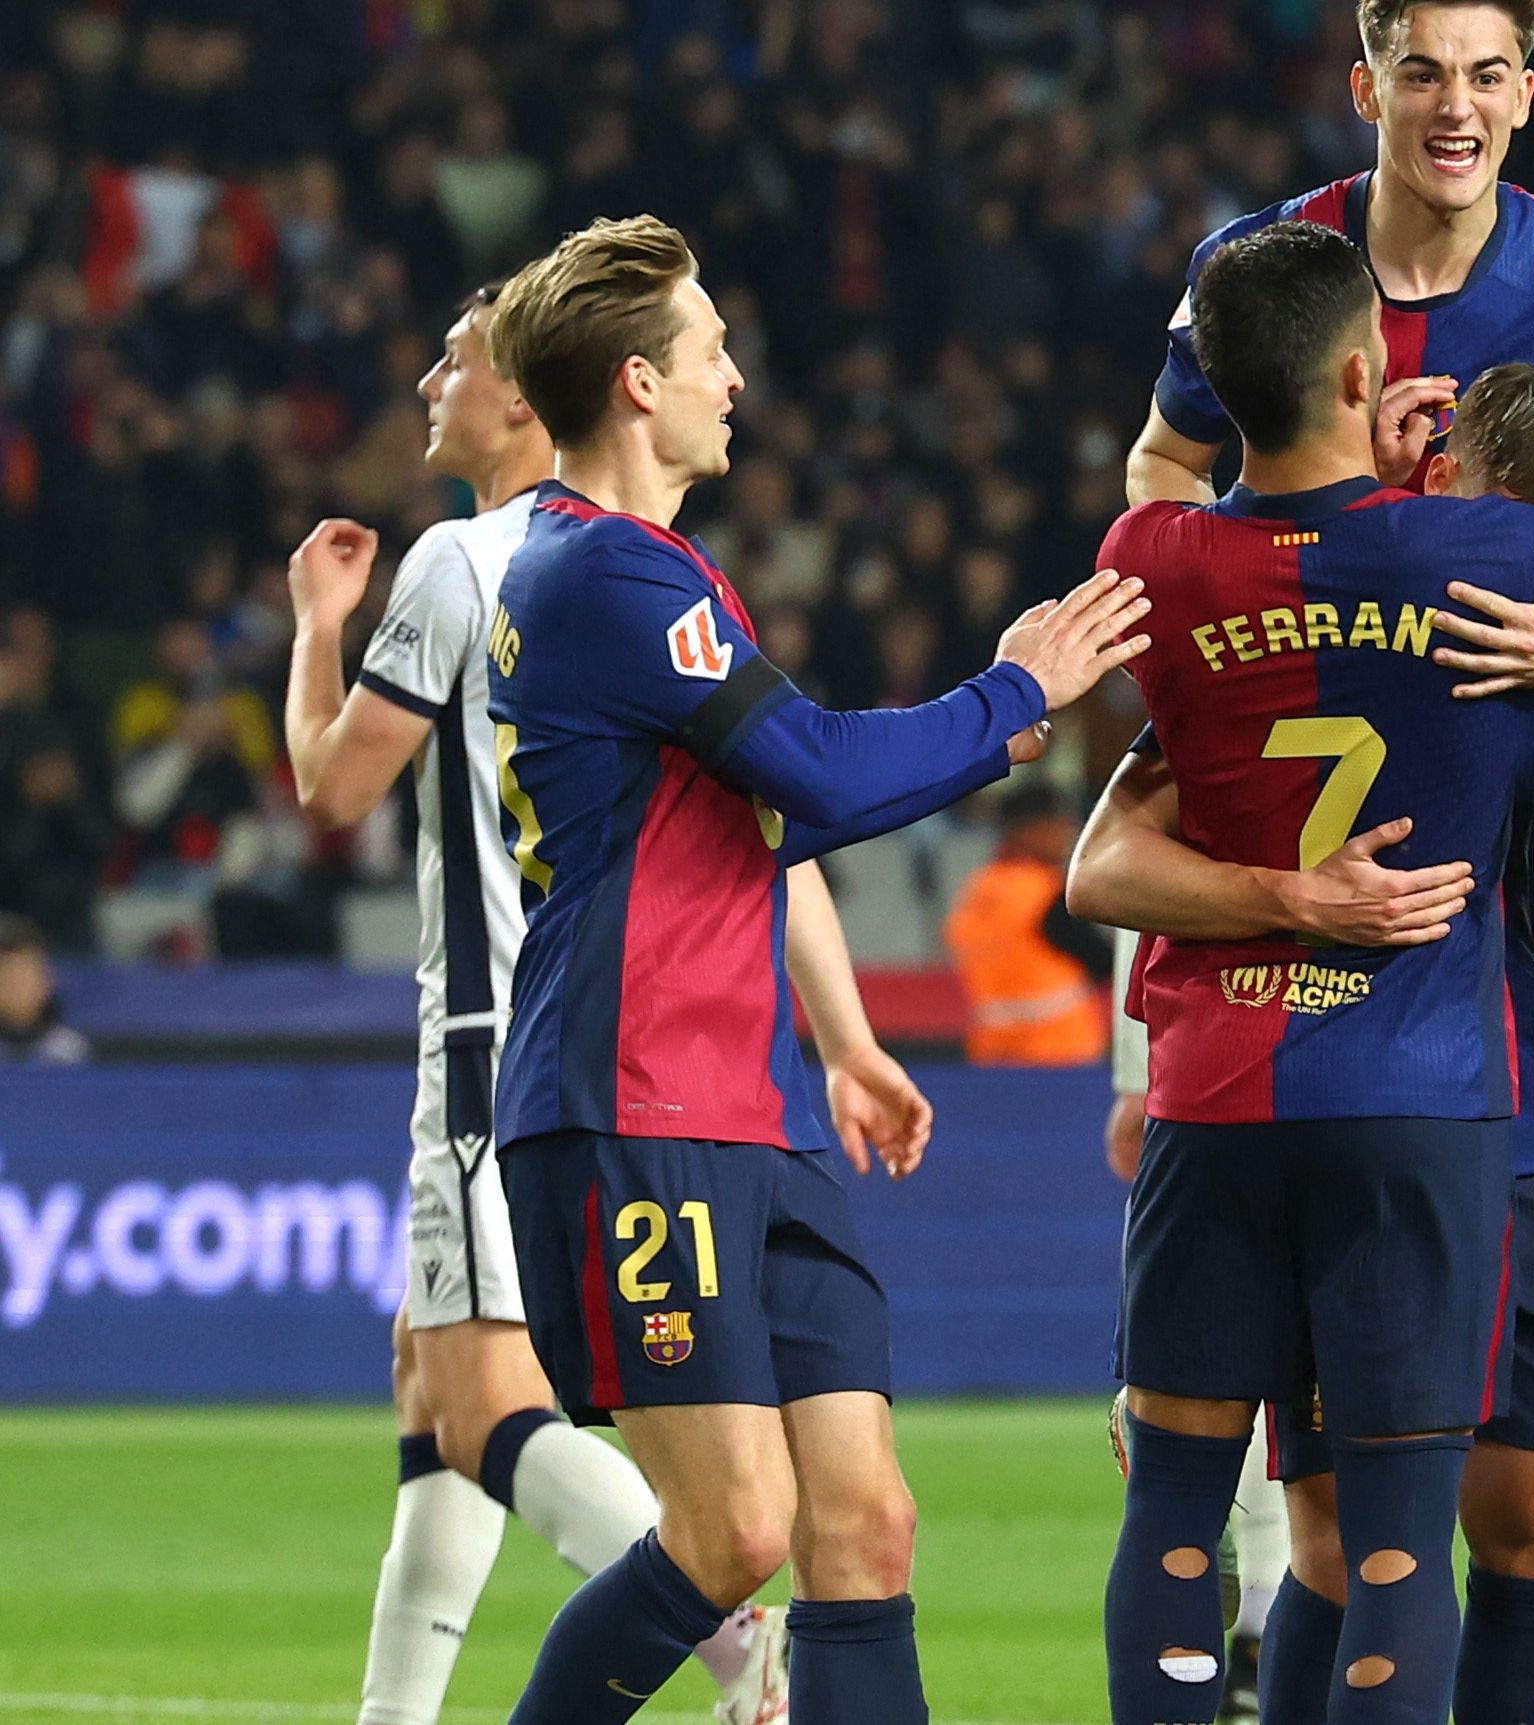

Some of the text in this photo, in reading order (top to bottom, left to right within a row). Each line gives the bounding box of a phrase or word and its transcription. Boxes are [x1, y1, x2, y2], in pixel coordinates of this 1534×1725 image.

[1190, 601, 1438, 672] FERRAN
[1260, 716, 1387, 876] 7
[615, 1200, 719, 1302] 21
